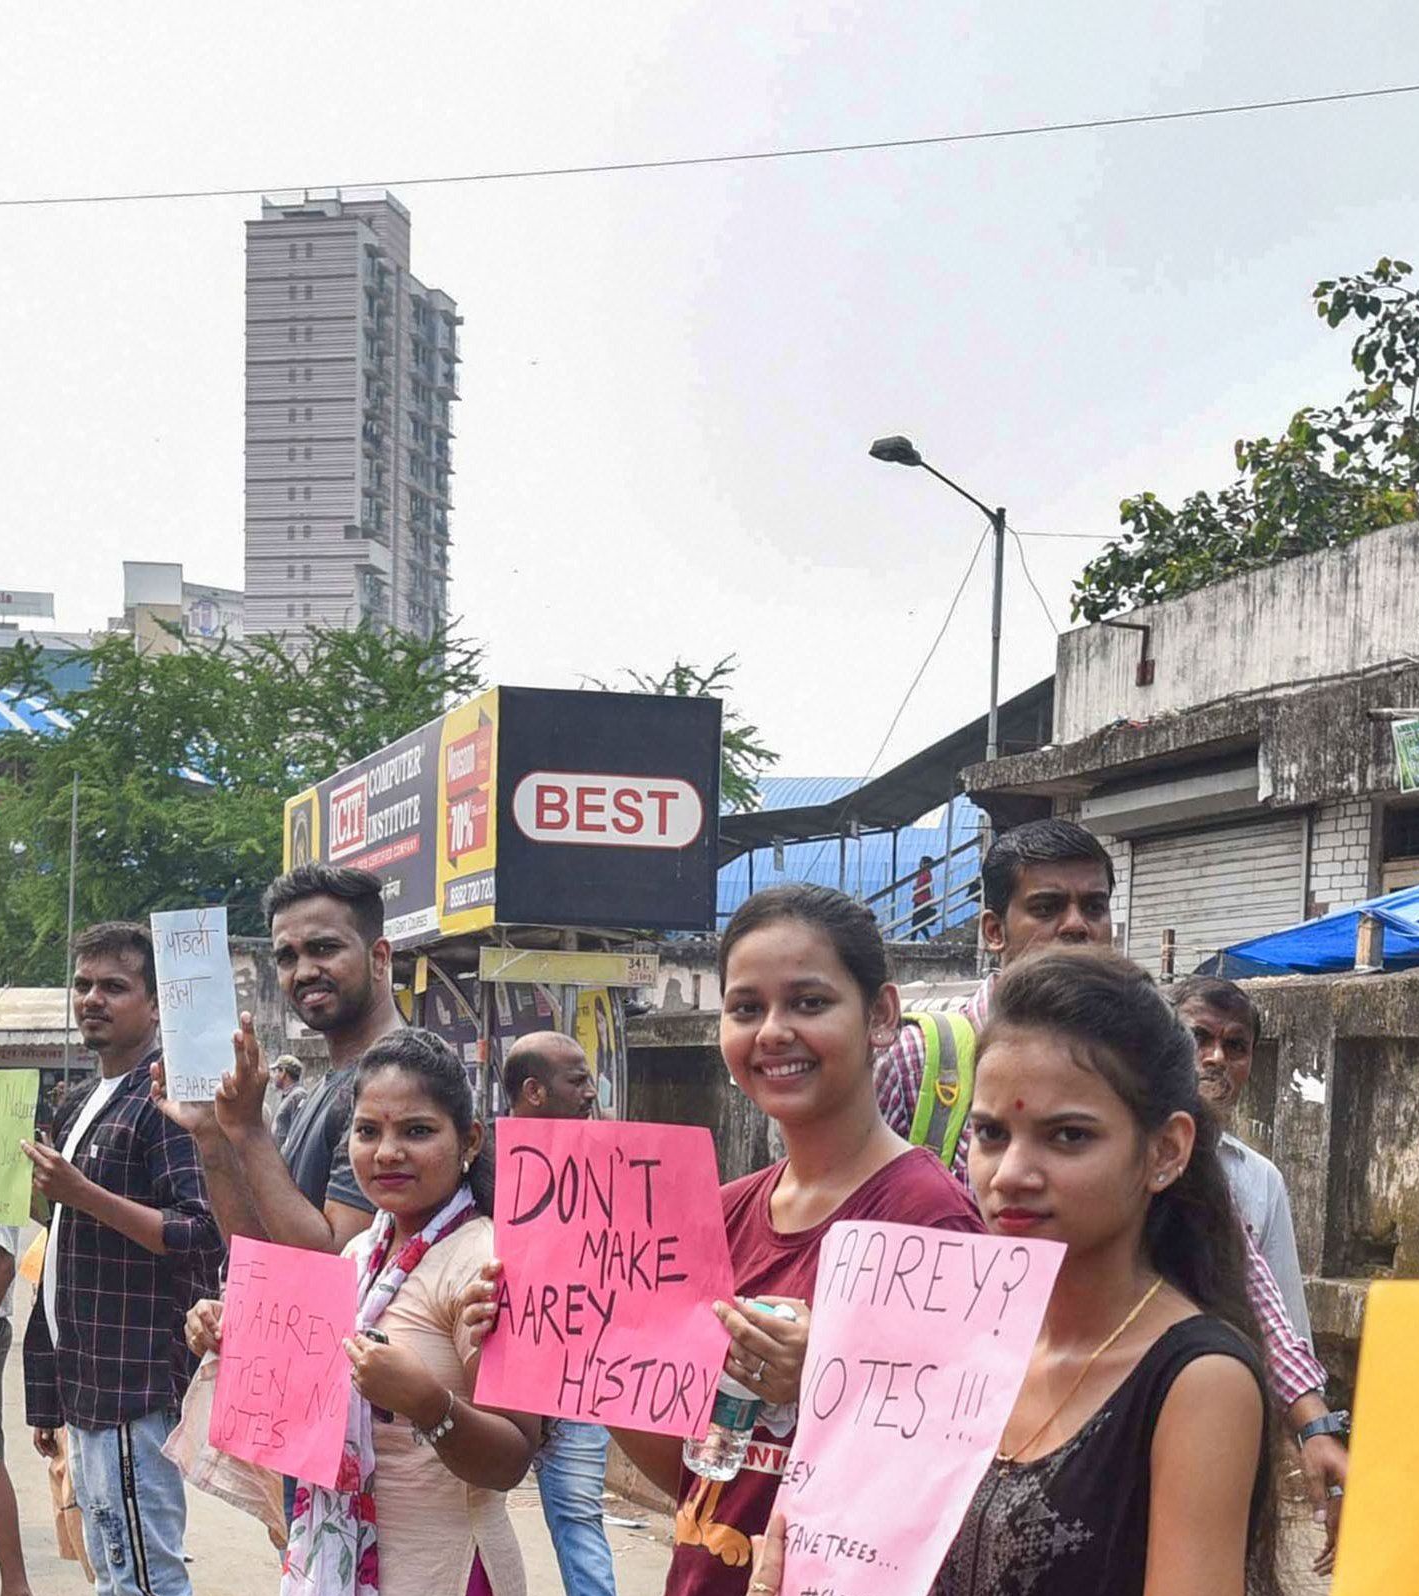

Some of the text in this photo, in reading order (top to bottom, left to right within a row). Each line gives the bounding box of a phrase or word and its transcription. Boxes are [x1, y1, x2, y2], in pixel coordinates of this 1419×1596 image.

[367, 744, 422, 798] COMPUTER
[331, 790, 363, 847] ICIT
[367, 794, 421, 845] INSTITUTE
[535, 784, 680, 837] BEST
[507, 1145, 662, 1229] DON'T
[578, 1228, 688, 1293] MAKE
[249, 1301, 348, 1377] AAREY
[491, 1280, 617, 1368] AAREY
[225, 1356, 292, 1409] THEN
[557, 1348, 719, 1436] HISTORY
